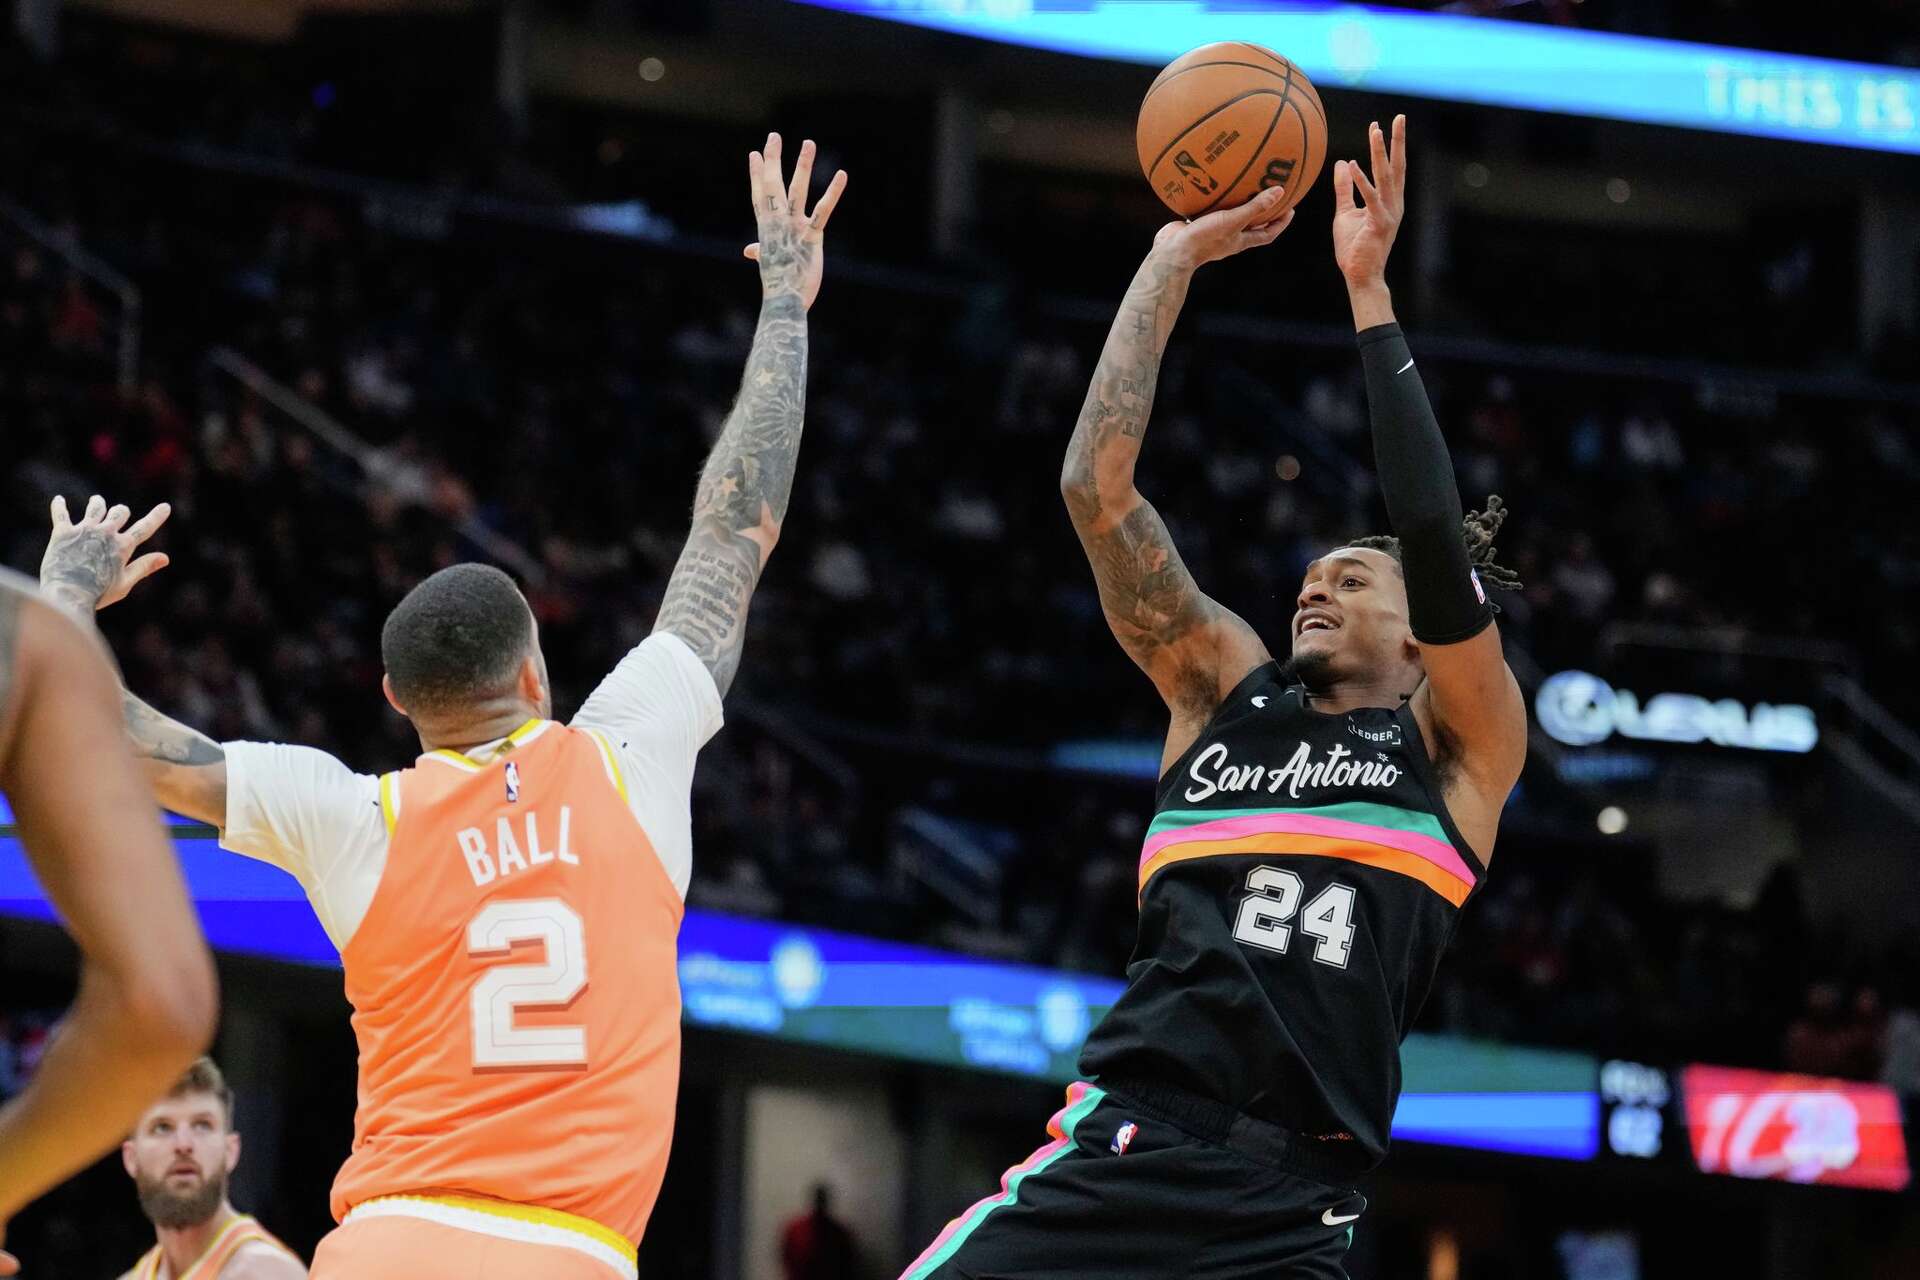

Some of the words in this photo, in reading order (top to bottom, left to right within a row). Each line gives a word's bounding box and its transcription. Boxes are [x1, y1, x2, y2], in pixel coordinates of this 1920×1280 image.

[1184, 743, 1268, 803] San
[1267, 741, 1403, 799] Antonio
[1351, 725, 1394, 742] LEDGER
[456, 805, 581, 887] BALL
[1232, 864, 1357, 970] 24
[466, 897, 590, 1075] 2
